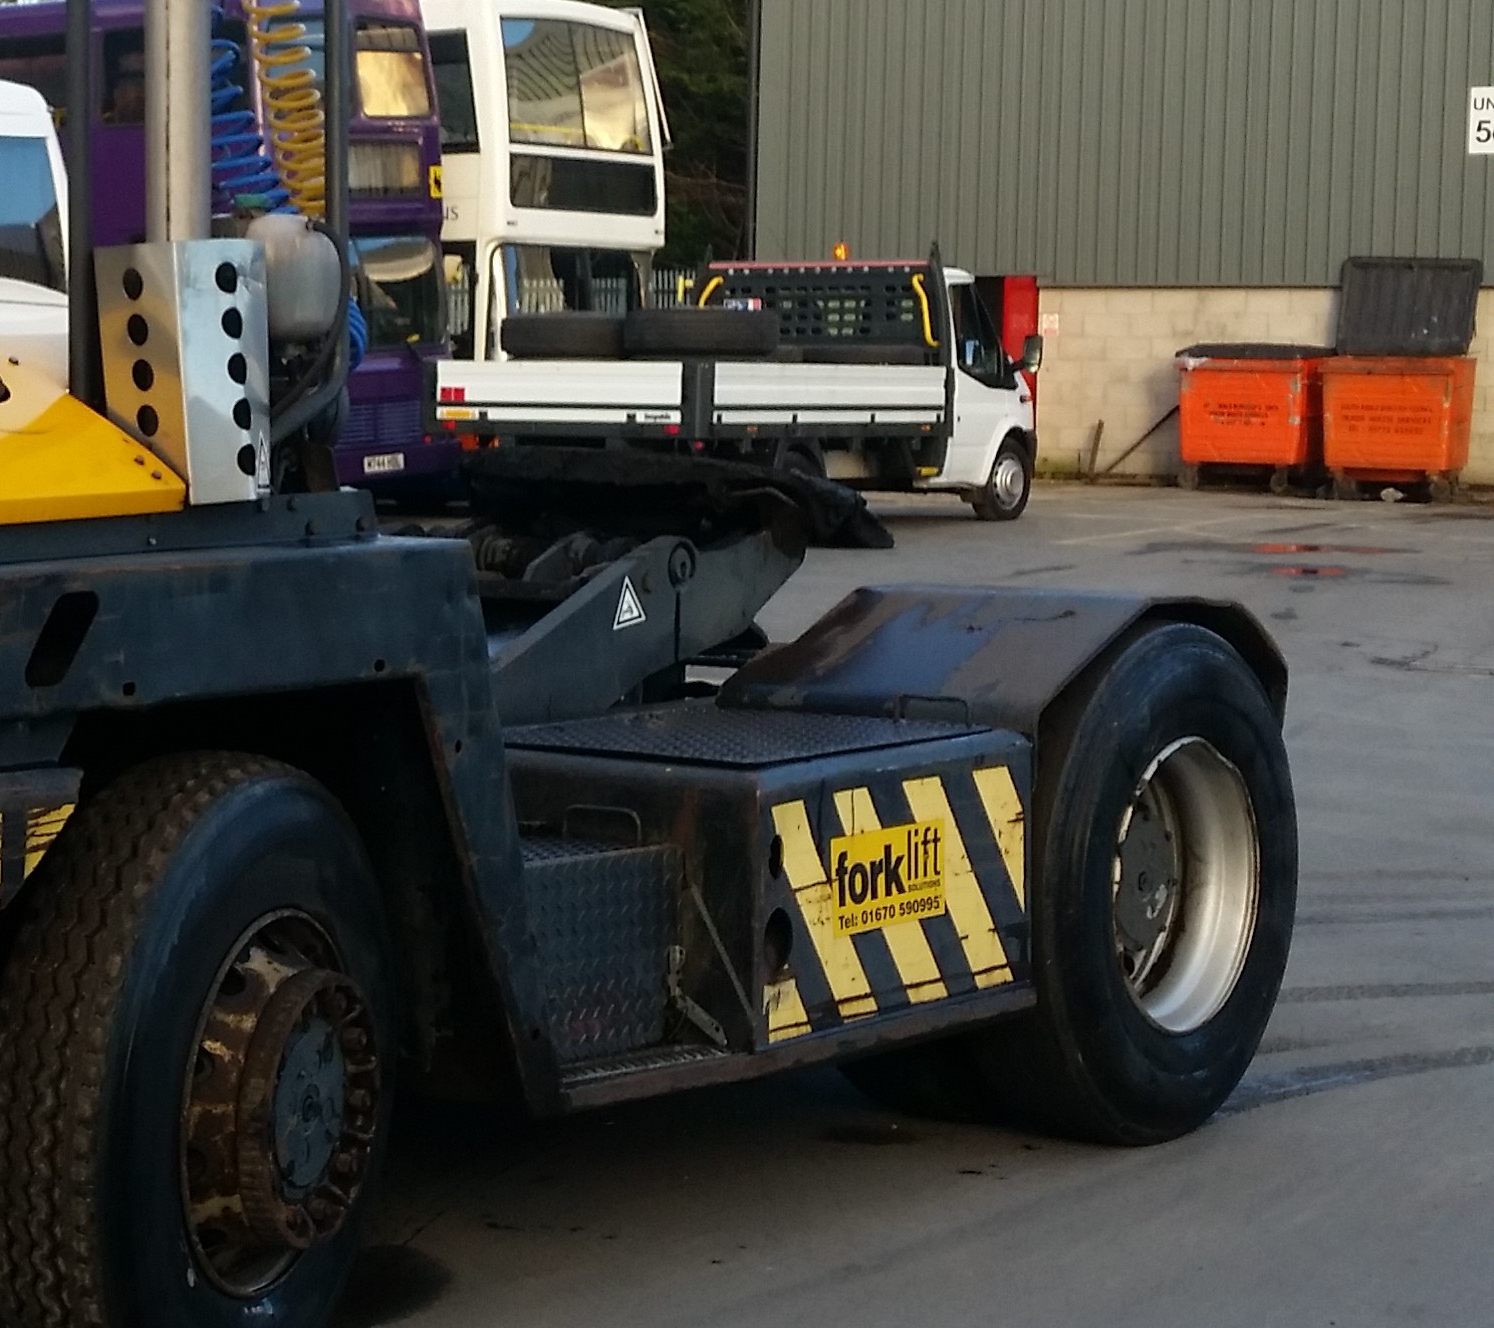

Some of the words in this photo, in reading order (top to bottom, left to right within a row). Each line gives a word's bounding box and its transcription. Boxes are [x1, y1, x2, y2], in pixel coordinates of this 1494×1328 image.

[908, 879, 941, 892] SOLUTIONS
[839, 913, 858, 930] Tel:
[861, 904, 896, 925] 01670
[899, 896, 940, 916] 590995
